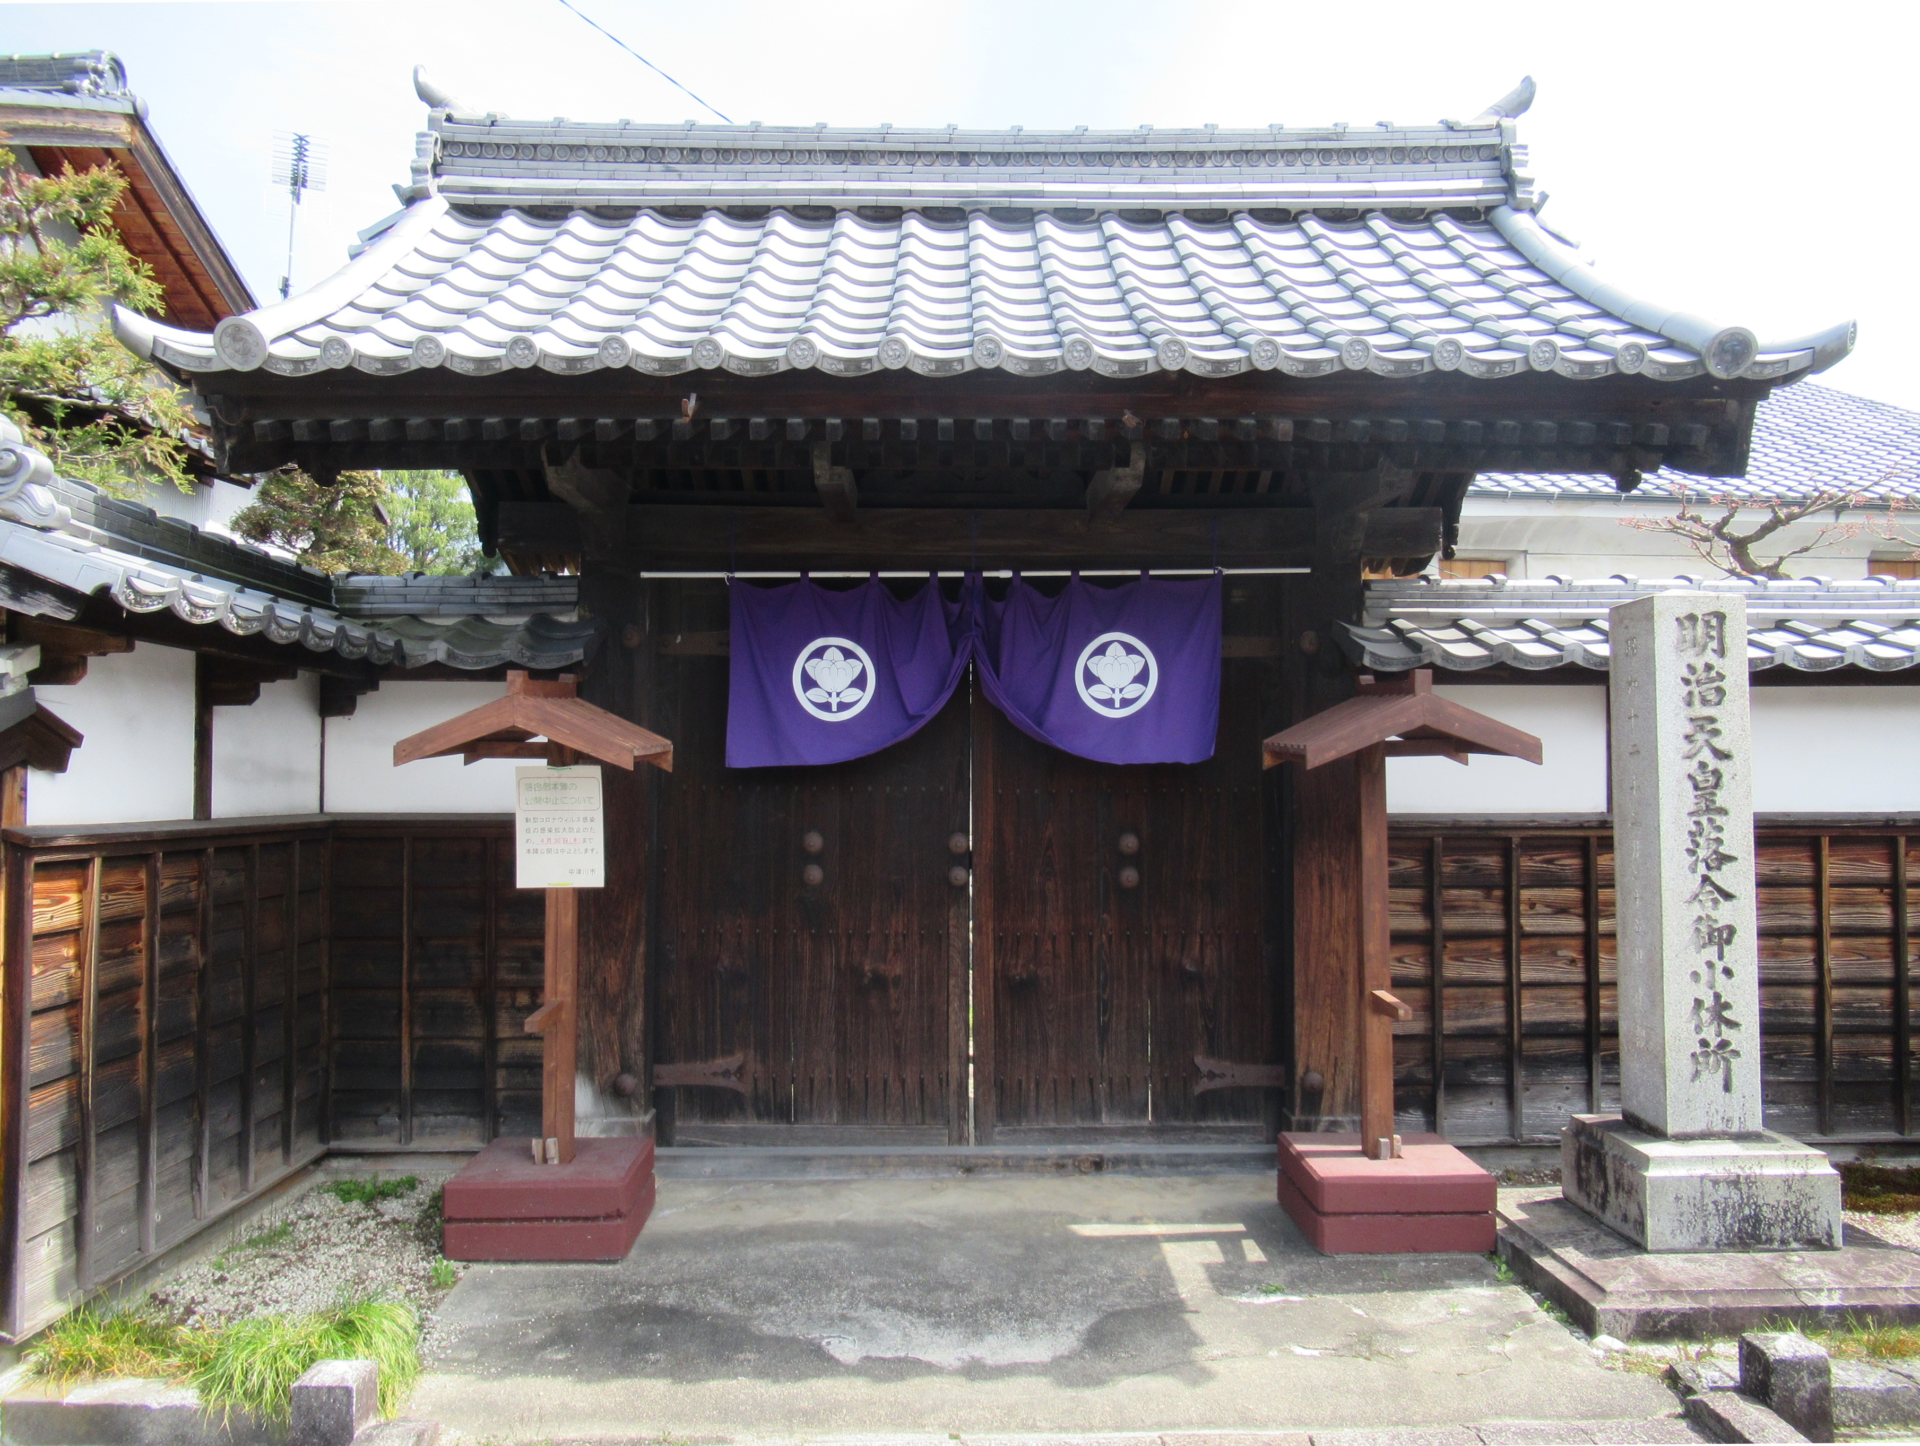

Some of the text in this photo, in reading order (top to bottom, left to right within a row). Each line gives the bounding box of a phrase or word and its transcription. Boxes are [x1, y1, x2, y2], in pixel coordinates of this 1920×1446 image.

[525, 796, 595, 805] 公開中止について
[1675, 610, 1742, 1093] 明治天皇落合御小休所
